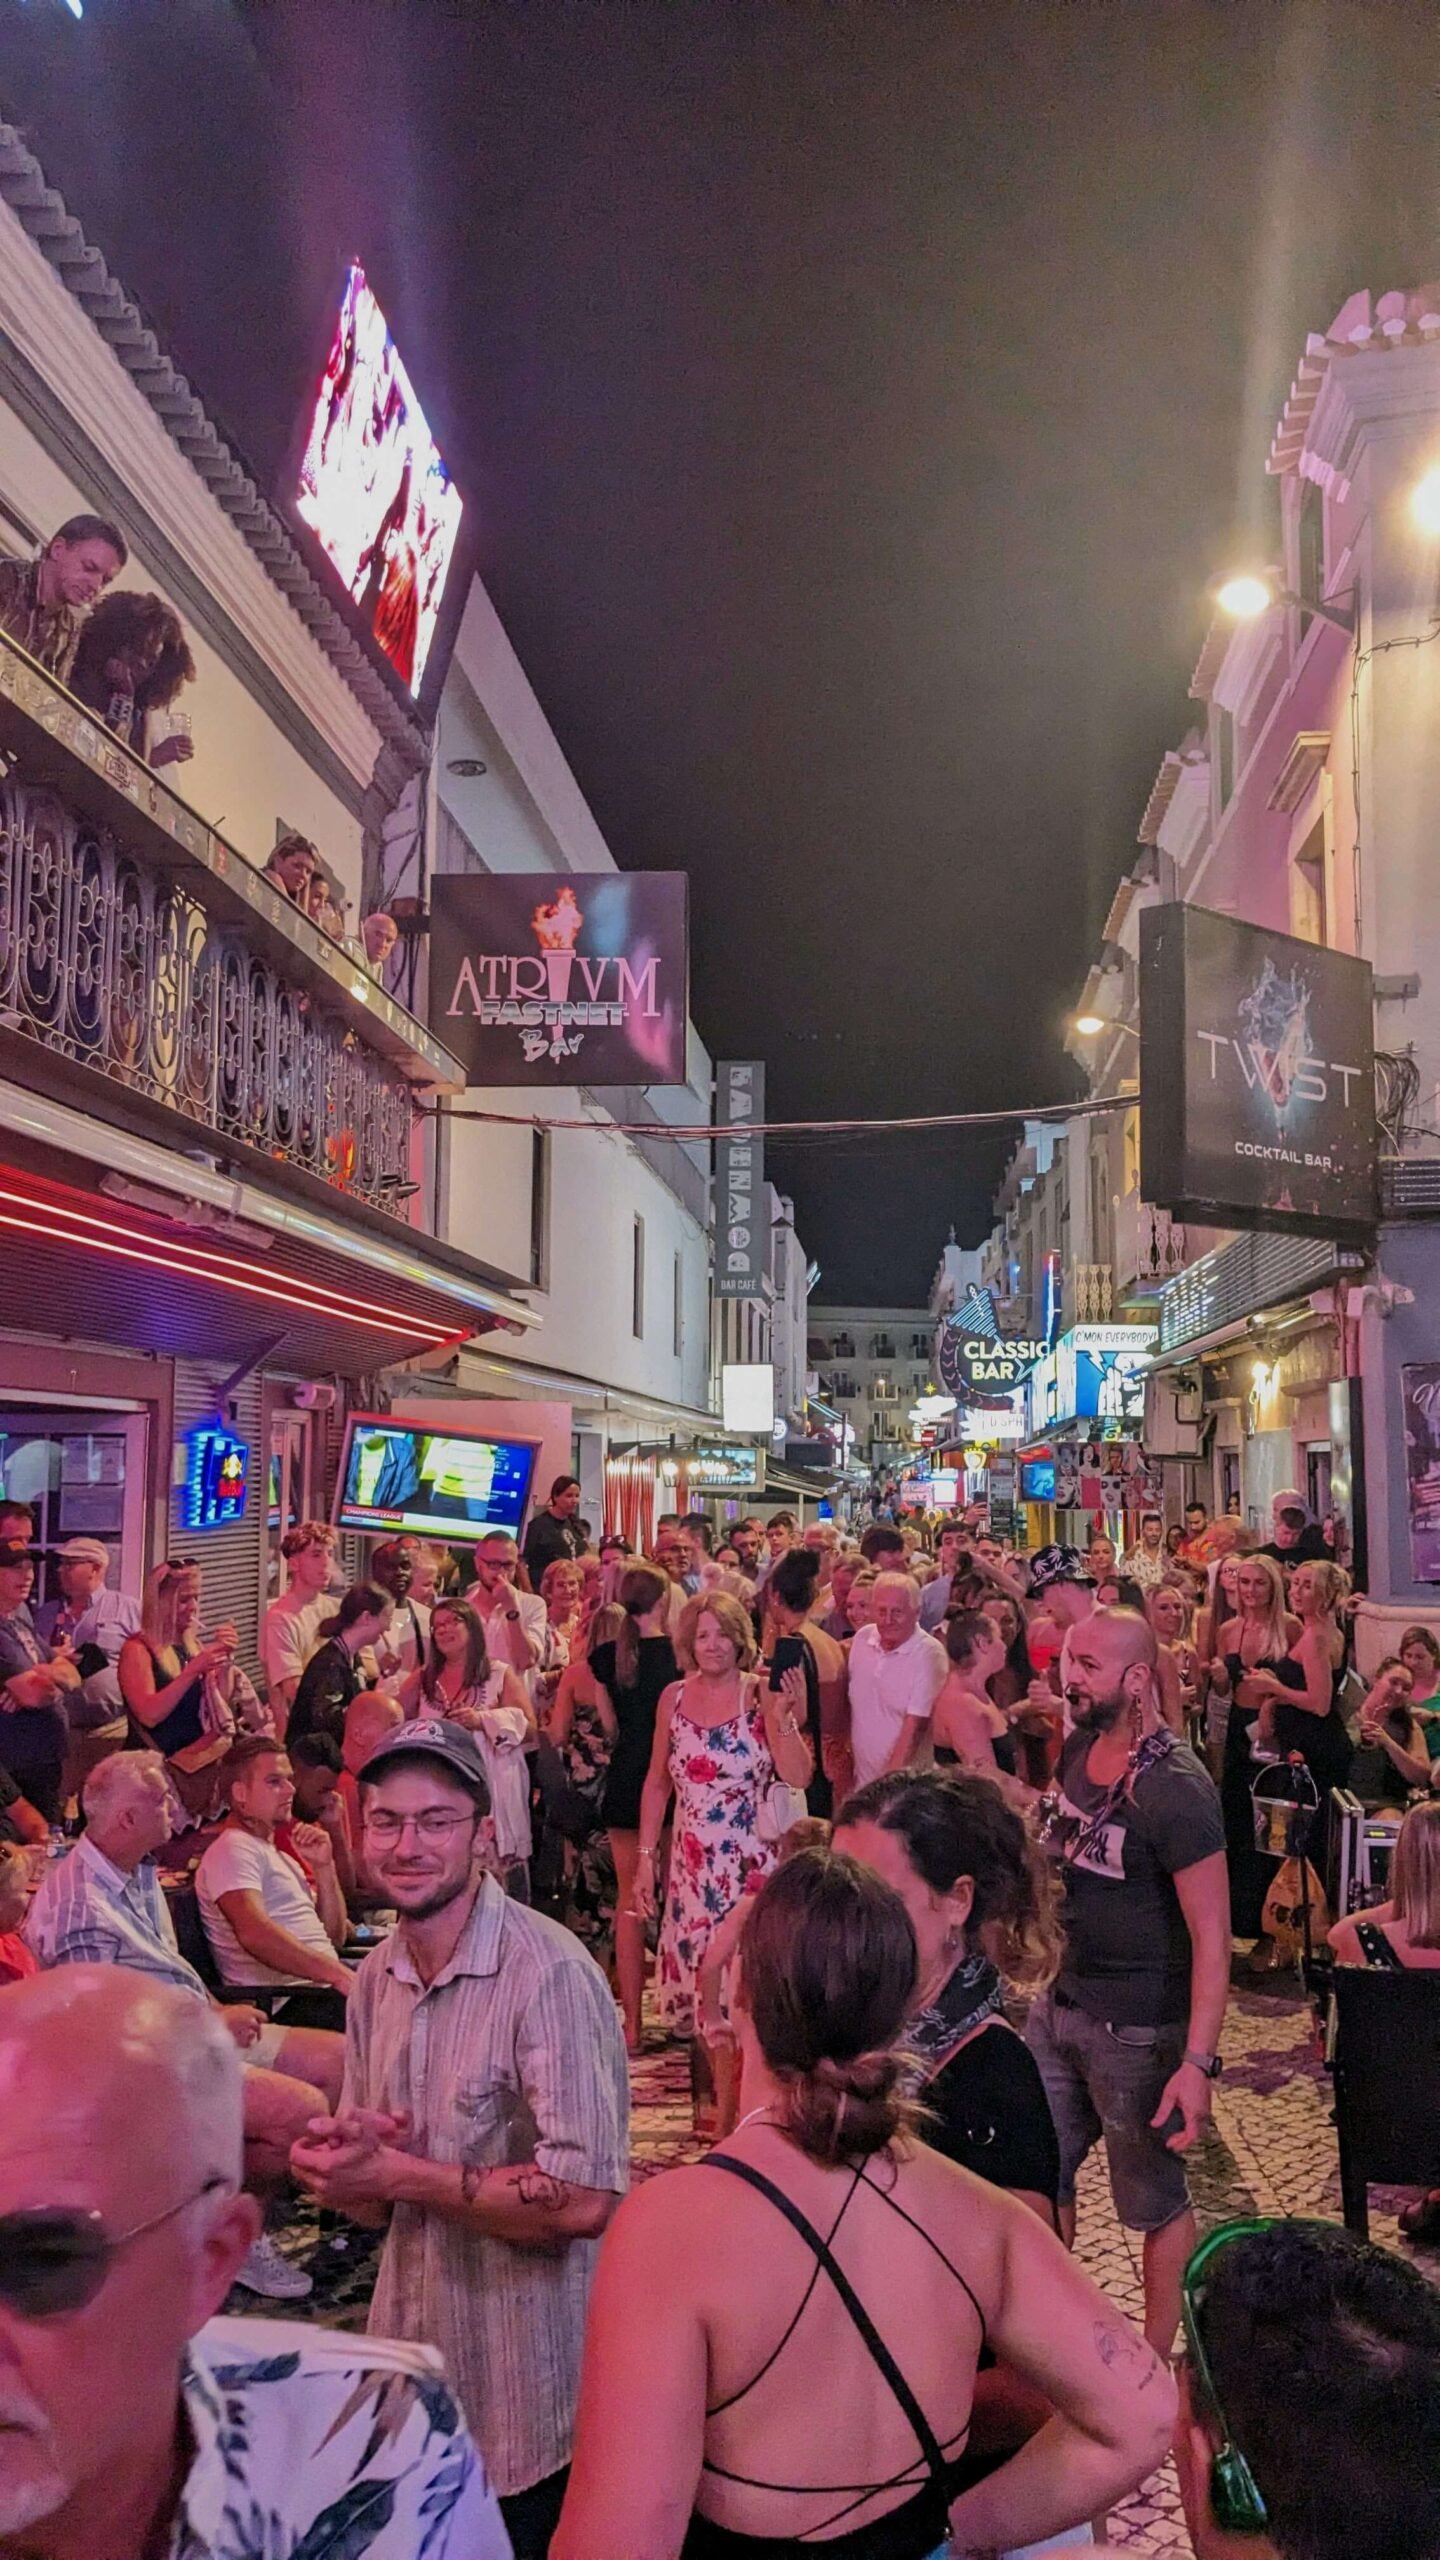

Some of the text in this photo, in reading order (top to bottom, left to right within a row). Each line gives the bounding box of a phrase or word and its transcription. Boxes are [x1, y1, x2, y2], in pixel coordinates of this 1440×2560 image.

[480, 1001, 627, 1026] FASTNET
[519, 1029, 585, 1063] Bar
[1234, 1141, 1332, 1169] COCKTAIL BAR
[1075, 1330, 1158, 1344] C'MON EVERYBODY!
[963, 1341, 1051, 1360] CLASSIC
[972, 1361, 1014, 1380] BAR
